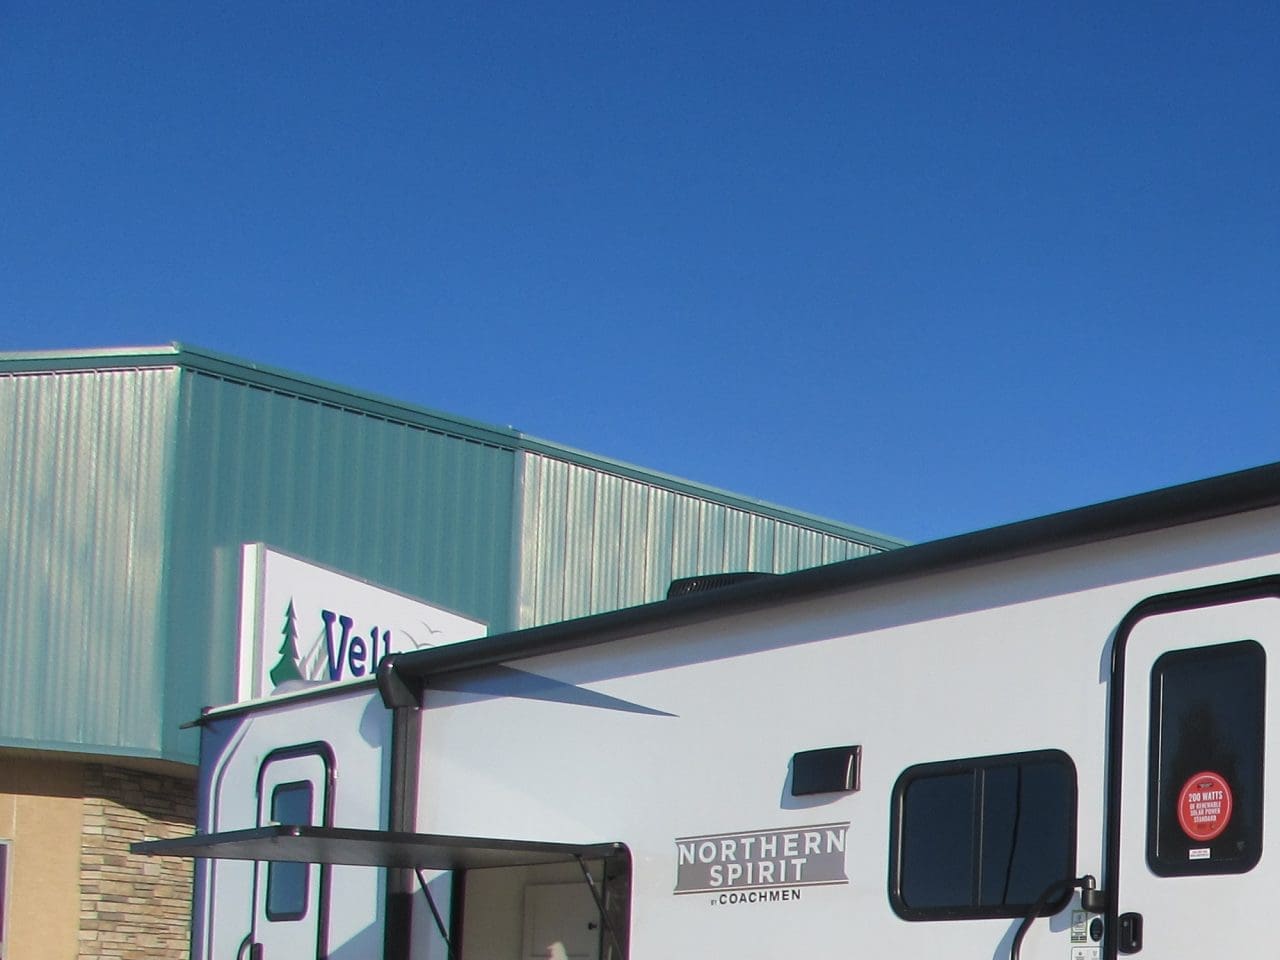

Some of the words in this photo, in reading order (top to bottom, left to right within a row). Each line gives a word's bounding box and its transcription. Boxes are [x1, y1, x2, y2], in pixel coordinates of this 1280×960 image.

[1188, 793, 1201, 803] 200
[1202, 790, 1223, 801] WATTS
[679, 829, 846, 866] NORTHERN
[709, 858, 807, 887] SPIRIT
[719, 889, 801, 905] COACHMEN
